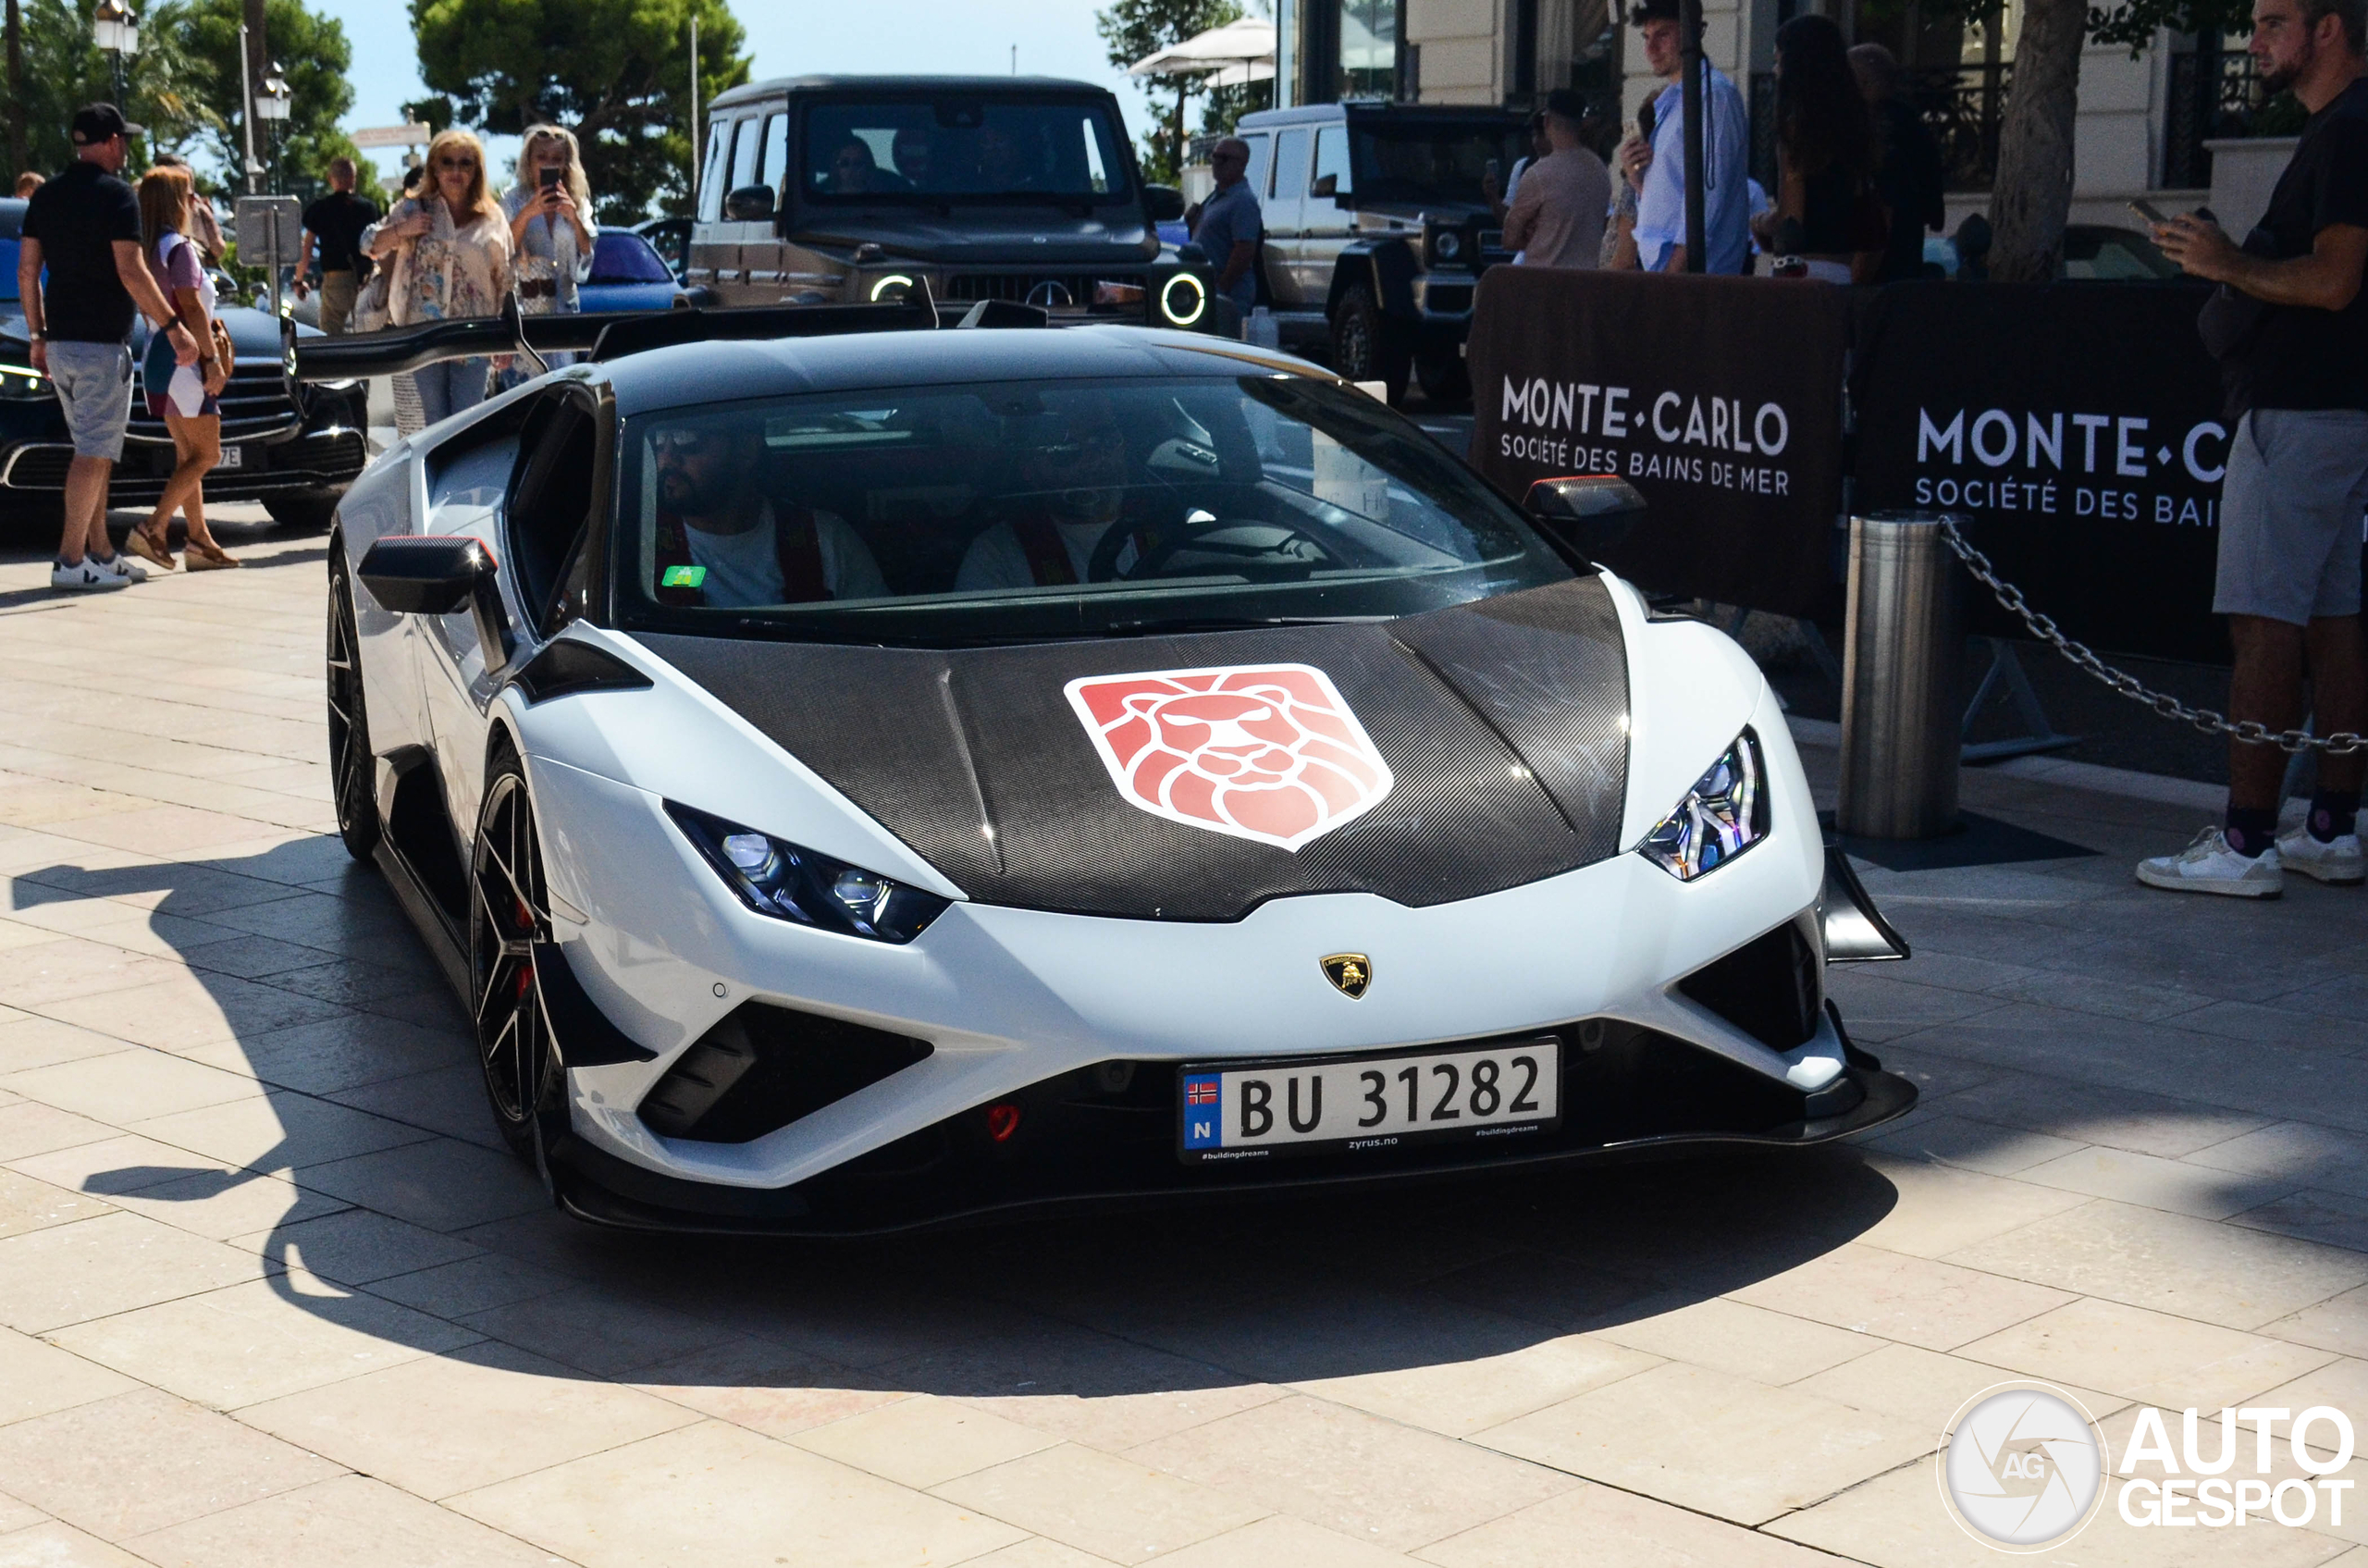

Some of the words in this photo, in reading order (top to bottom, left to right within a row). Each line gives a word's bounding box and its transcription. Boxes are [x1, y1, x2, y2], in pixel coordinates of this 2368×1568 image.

[1501, 433, 1567, 467] SOCIÉTÉ
[1574, 445, 1618, 473] DES
[1629, 452, 1703, 484] BAINS
[1711, 462, 1733, 489] DE
[1741, 466, 1789, 496] MER
[1916, 475, 2056, 513] SOCIÉTÉ
[2075, 488, 2139, 521] DES
[2154, 495, 2214, 527] BAI
[1240, 1075, 1323, 1138] BU
[1358, 1056, 1539, 1128] 31282
[1194, 1121, 1211, 1139] N
[1475, 1125, 1538, 1136] #buildingdreams
[1349, 1136, 1398, 1150] zyrus.no
[1202, 1150, 1269, 1160] #buildingdreams
